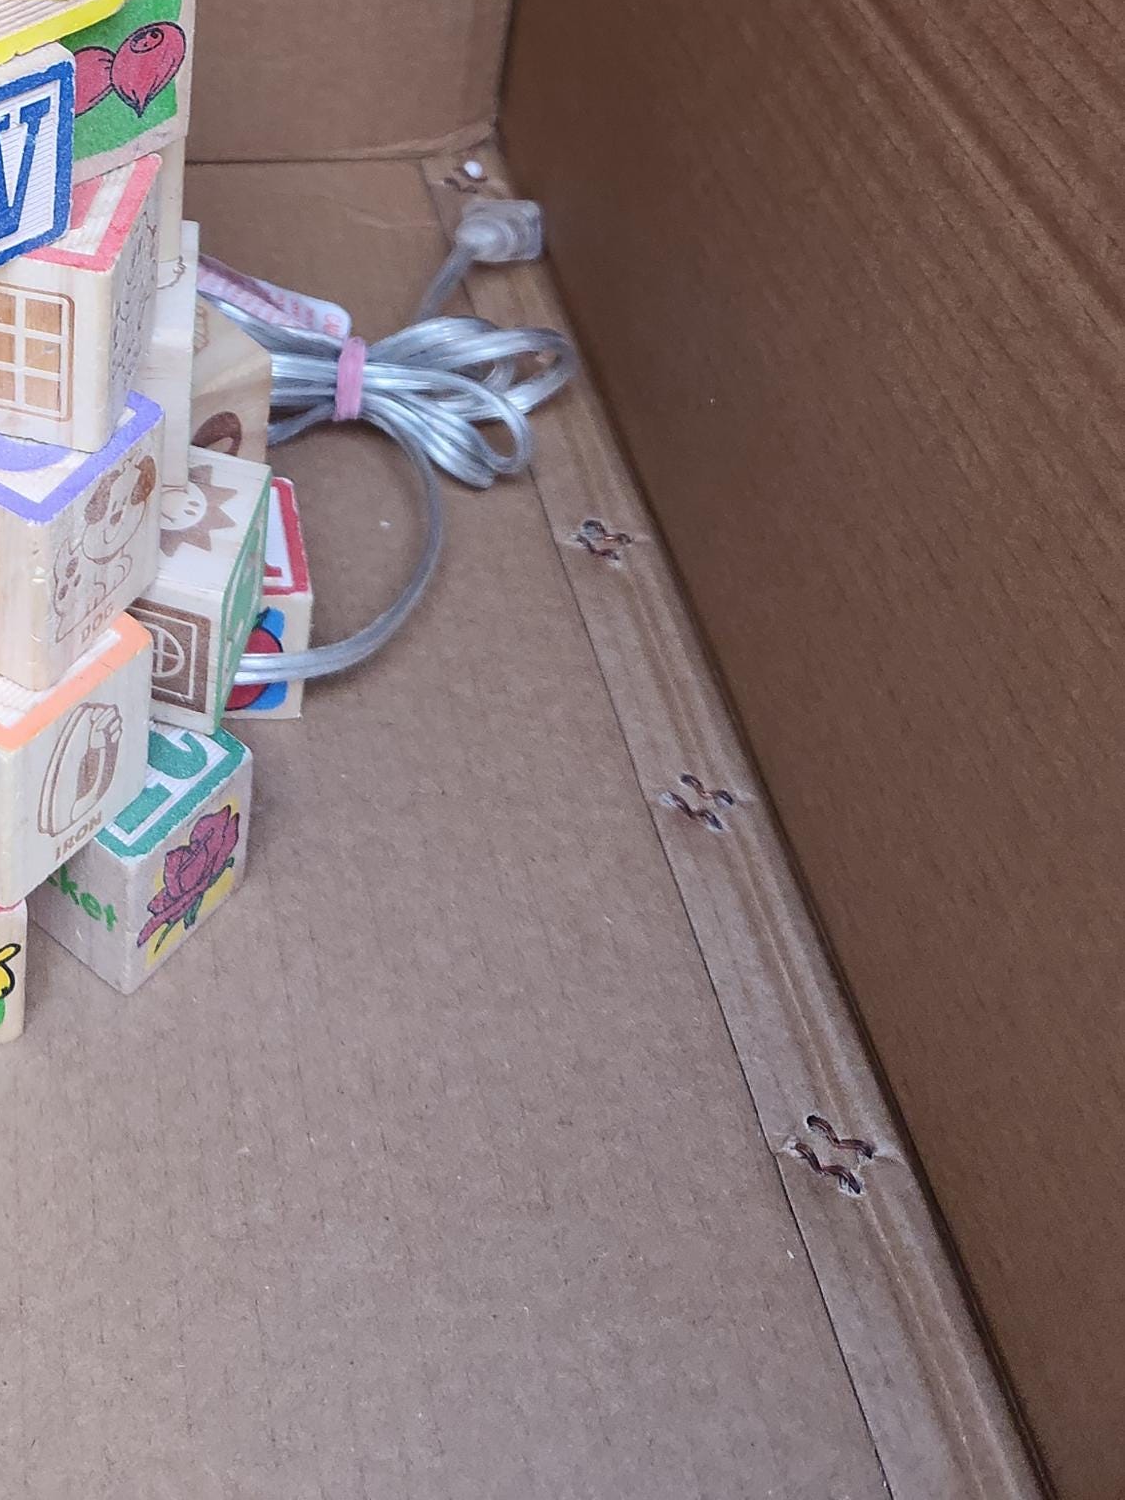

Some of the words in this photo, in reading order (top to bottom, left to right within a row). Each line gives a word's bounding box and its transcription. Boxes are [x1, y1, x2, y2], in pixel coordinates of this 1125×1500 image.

[81, 601, 114, 644] DOG
[55, 810, 103, 861] IRON
[46, 863, 119, 932] ket
